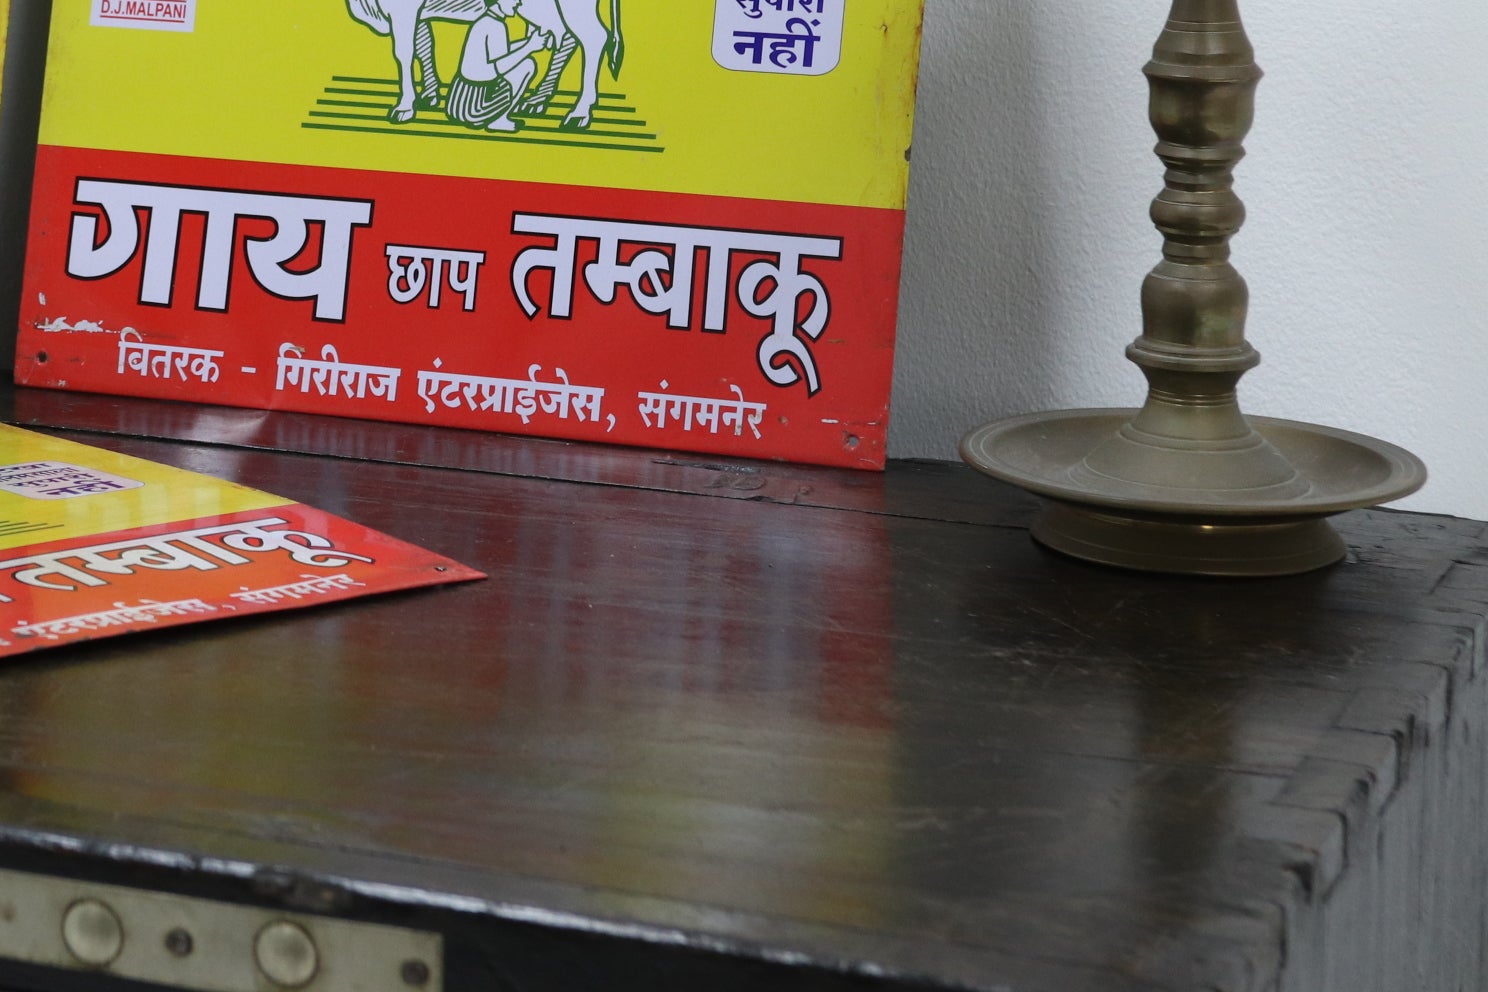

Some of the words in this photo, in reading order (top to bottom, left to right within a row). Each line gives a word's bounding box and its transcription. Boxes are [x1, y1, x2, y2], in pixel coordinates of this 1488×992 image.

[733, 17, 821, 68] नहीं
[66, 176, 374, 324] गाय
[384, 243, 485, 312] छाप
[511, 212, 845, 396] तम्बाकू
[275, 342, 401, 401] गिरीराज
[638, 379, 767, 440] संगमनेर
